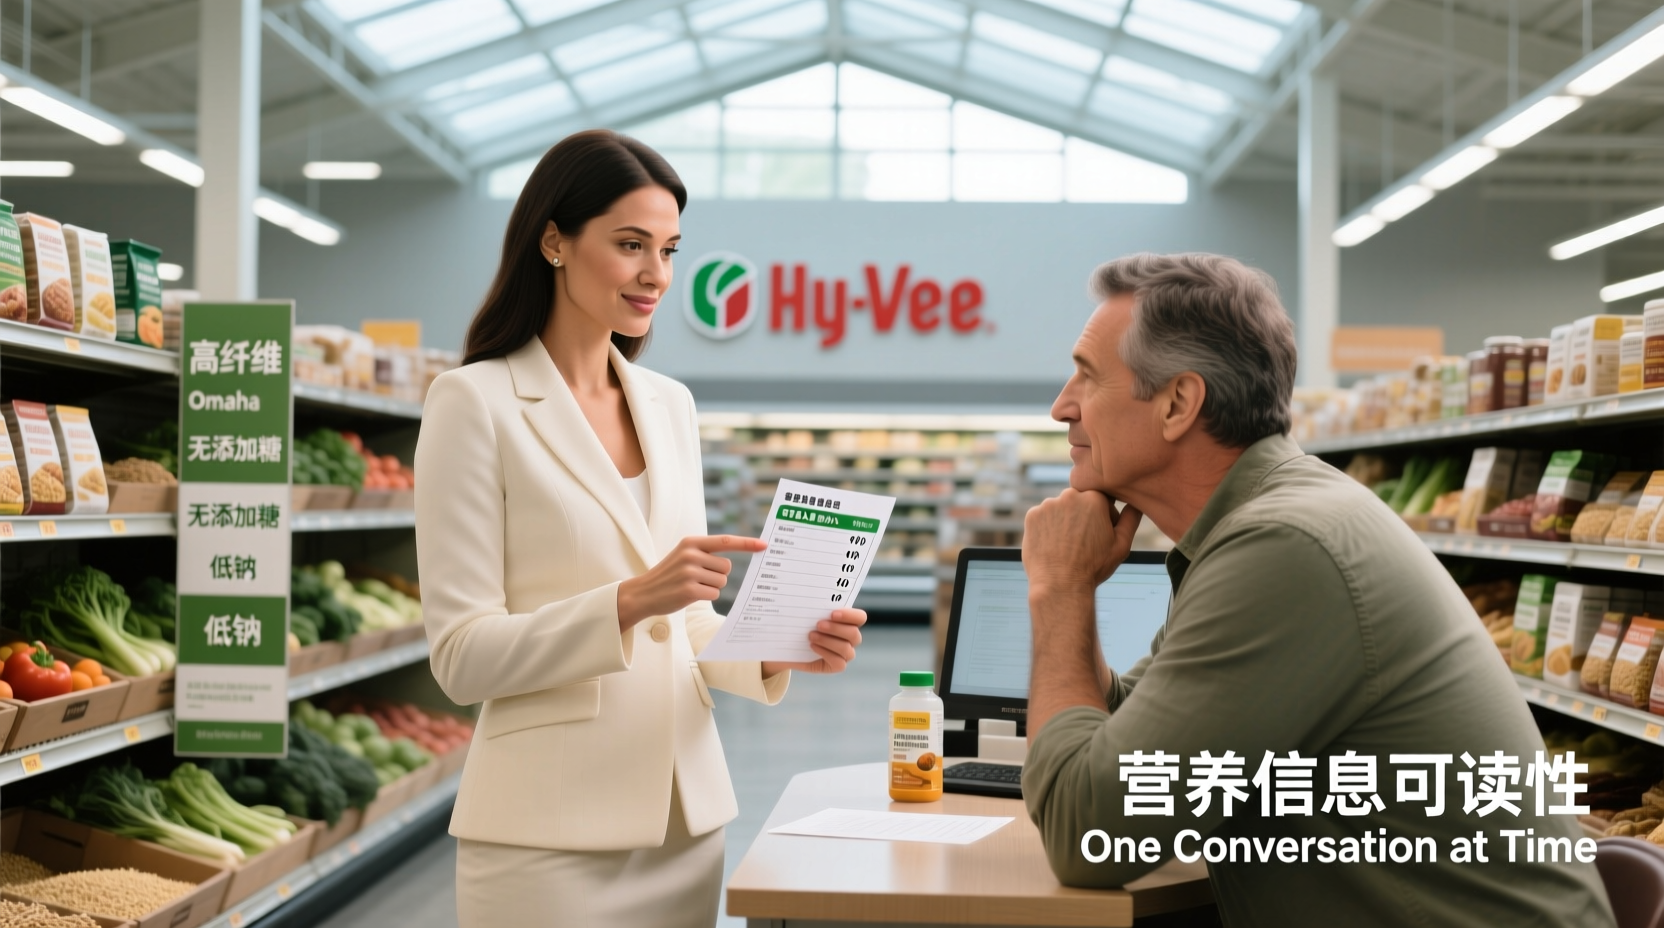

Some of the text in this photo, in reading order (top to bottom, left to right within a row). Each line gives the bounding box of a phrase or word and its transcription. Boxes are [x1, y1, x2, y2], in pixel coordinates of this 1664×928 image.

[769, 263, 984, 350] Hy-Vee
[189, 339, 282, 375] 高纤维
[188, 389, 260, 412] Omaha
[187, 435, 282, 463] 无添加糖
[187, 503, 280, 529] 无添加糖
[209, 554, 257, 580] 低钠
[203, 613, 262, 647] 低钠
